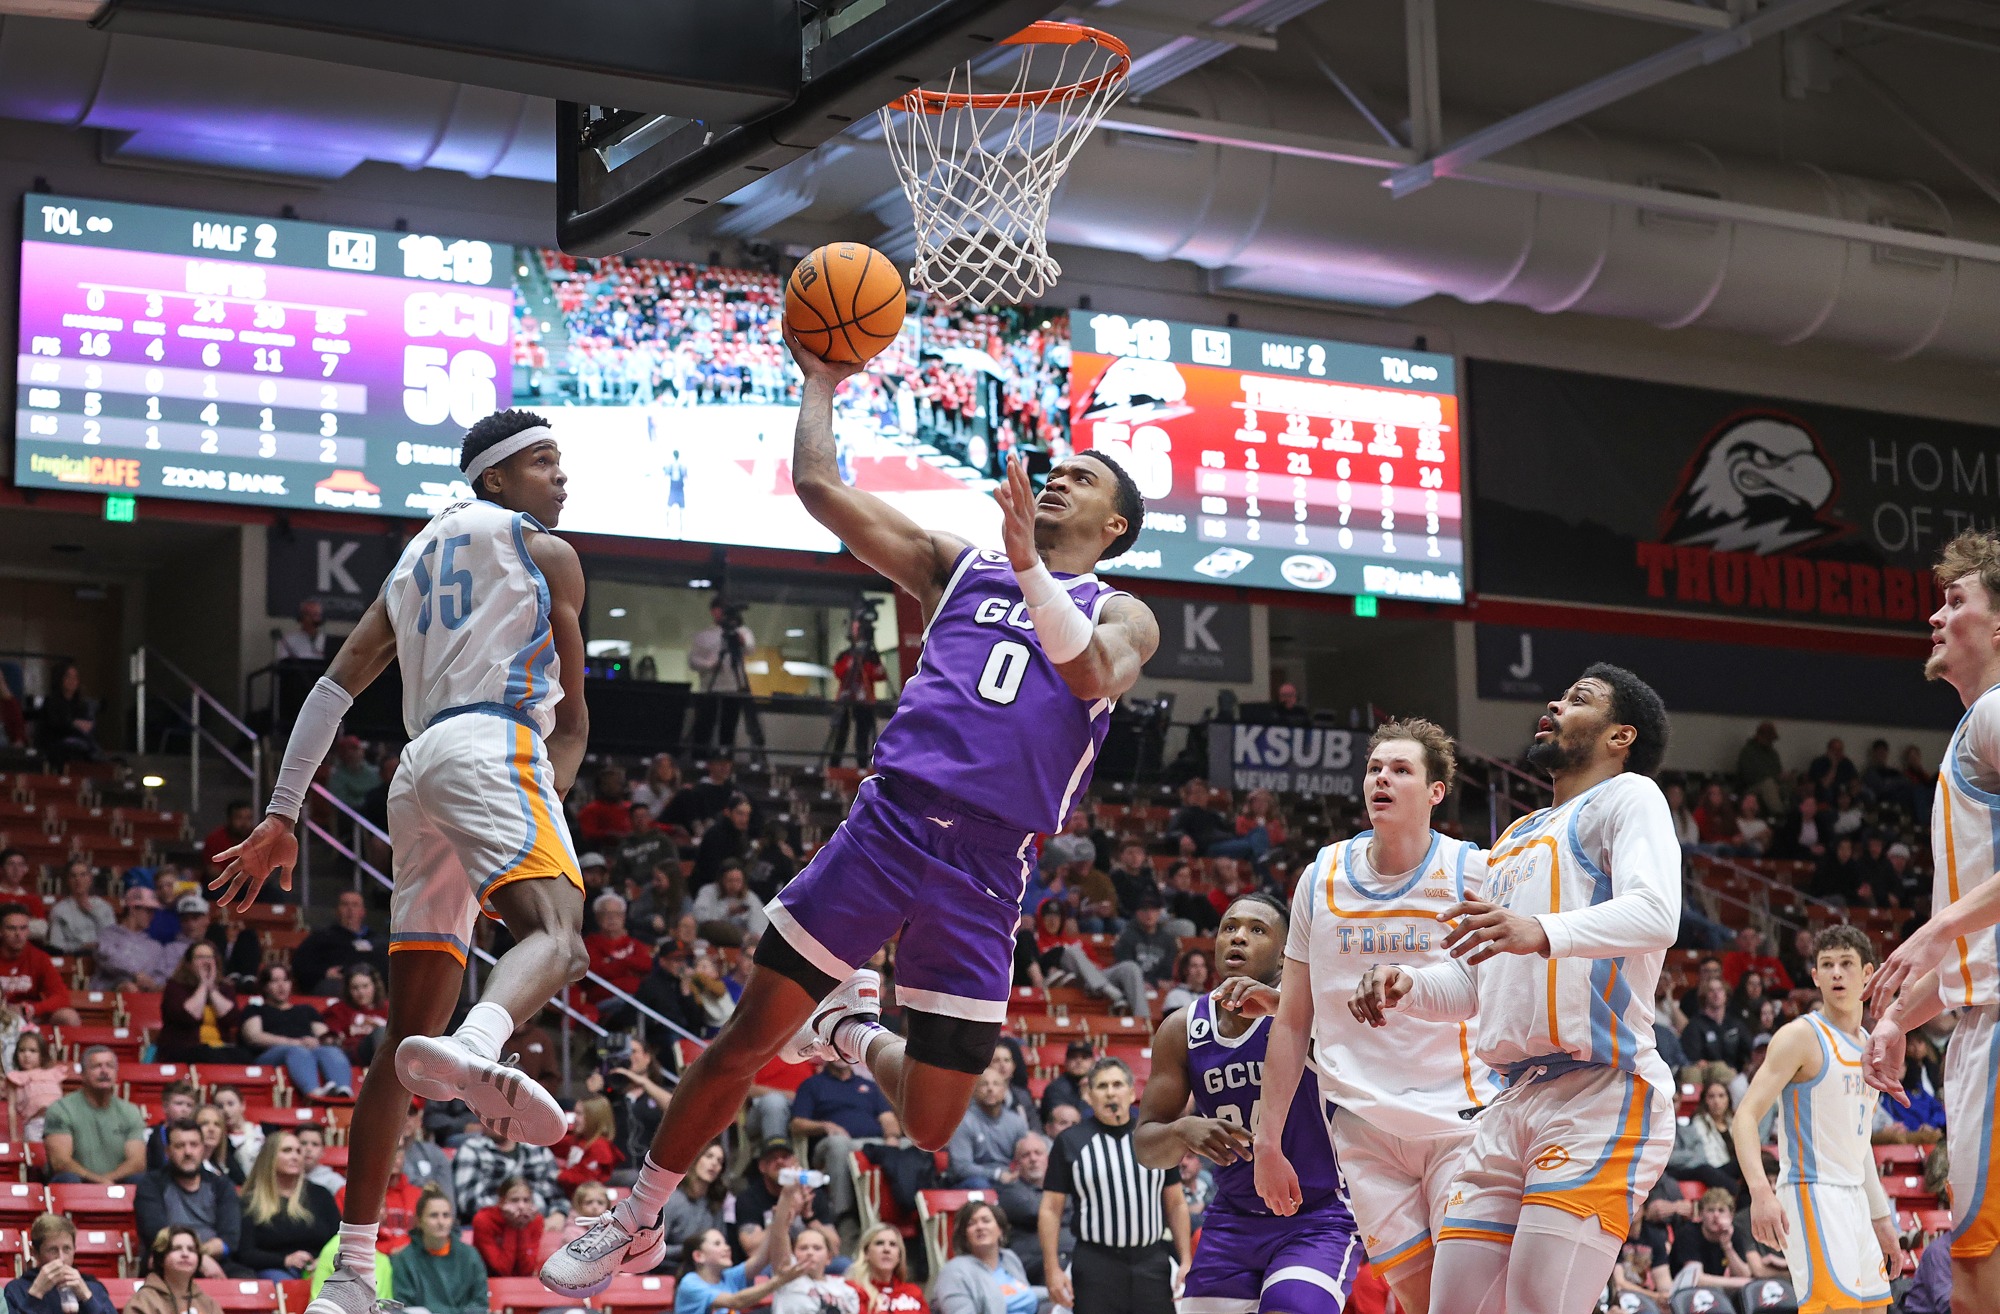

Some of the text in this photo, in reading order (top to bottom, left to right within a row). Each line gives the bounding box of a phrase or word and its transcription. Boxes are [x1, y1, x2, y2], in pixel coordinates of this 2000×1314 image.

[41, 206, 82, 235] TOL
[192, 221, 277, 258] HALF 2
[87, 288, 105, 312] 0
[145, 294, 163, 318] 3
[193, 299, 226, 324] 24
[79, 331, 111, 357] 16
[145, 338, 165, 361] 4
[202, 342, 221, 367] 6
[253, 348, 283, 373] 11
[320, 353, 339, 377] 7
[1261, 342, 1326, 376] HALF 2
[1380, 356, 1413, 384] TOL
[85, 365, 102, 389] 3
[145, 368, 164, 393] 0
[203, 374, 219, 398] 1
[258, 380, 277, 404] 0
[320, 385, 338, 409] 2
[403, 345, 497, 428] 56
[84, 392, 102, 416] 5
[146, 396, 162, 420] 1
[200, 402, 219, 426] 4
[259, 408, 275, 431] 1
[319, 413, 338, 437] 3
[83, 420, 101, 444] 2
[145, 426, 161, 450] 1
[200, 429, 219, 454] 2
[258, 433, 276, 458] 3
[319, 439, 338, 463] 2
[396, 441, 412, 465] 8
[162, 466, 284, 494] ZIONS BANK
[1244, 448, 1260, 470] 1
[1287, 452, 1312, 475] 21
[1336, 457, 1351, 479] 6
[1419, 466, 1443, 488] 14
[1245, 471, 1259, 493] 2
[1293, 476, 1306, 498] 2
[1868, 438, 2000, 498] HOM
[1246, 495, 1261, 517] 1
[1294, 499, 1307, 521] 5
[1338, 504, 1352, 525] 7
[1381, 508, 1394, 530] 2
[1426, 512, 1439, 534] 3
[1872, 502, 1932, 552] OF
[1246, 519, 1260, 541] 2
[1294, 523, 1309, 545] 1
[1338, 527, 1353, 550] 0
[1382, 532, 1397, 554] 1
[1426, 536, 1441, 557] 1
[317, 540, 361, 593] K
[1637, 541, 1945, 623] THUNDERBI
[974, 597, 1034, 631] GC
[1183, 603, 1221, 651] K
[977, 640, 1031, 705] 0
[1509, 633, 1533, 679] J
[1233, 724, 1352, 769] KSUB
[1234, 770, 1353, 795] NEWS RADIO
[1424, 888, 1450, 898] WAC
[1336, 924, 1431, 955] T-Birds
[1195, 1022, 1204, 1035] 4
[1203, 1061, 1265, 1095] GCU
